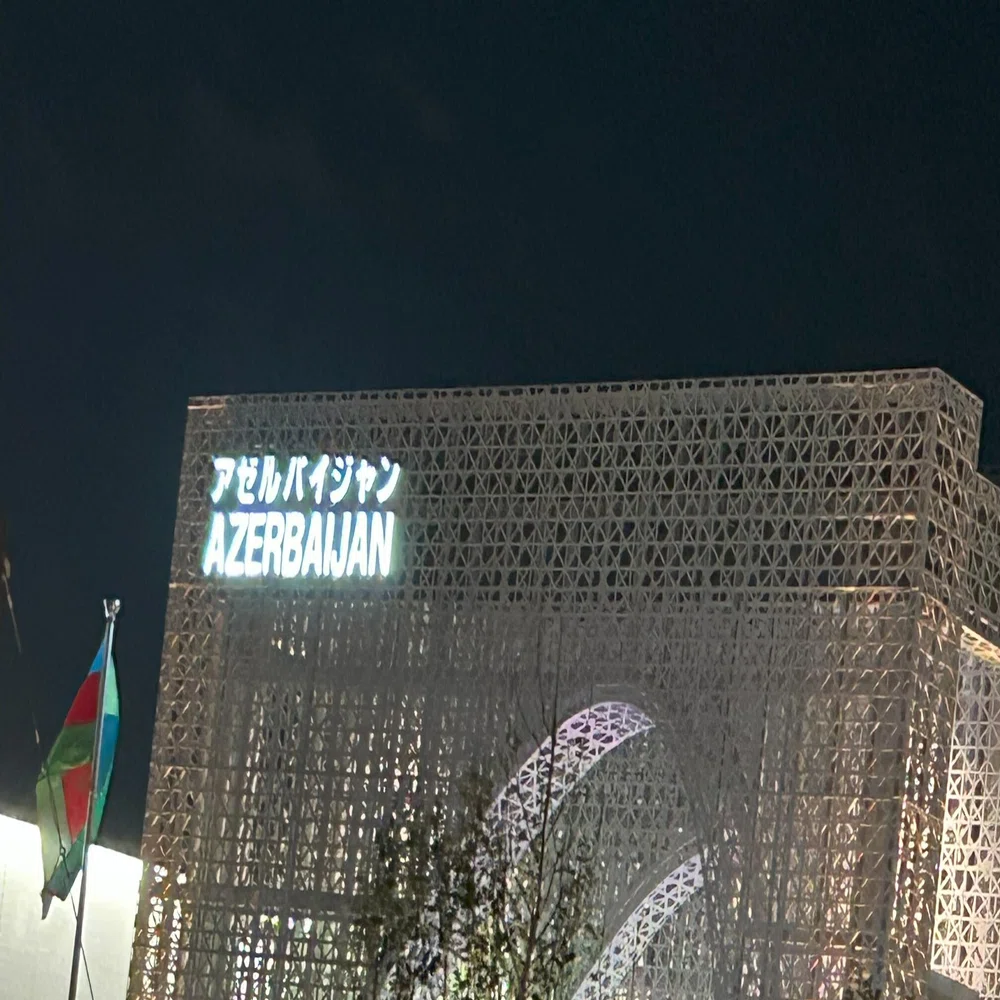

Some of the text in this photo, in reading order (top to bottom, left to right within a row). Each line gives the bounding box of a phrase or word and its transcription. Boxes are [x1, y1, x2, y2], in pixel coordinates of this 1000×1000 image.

[211, 455, 401, 504] アゼルバイジャン
[203, 511, 395, 577] AZERBAIJAN
